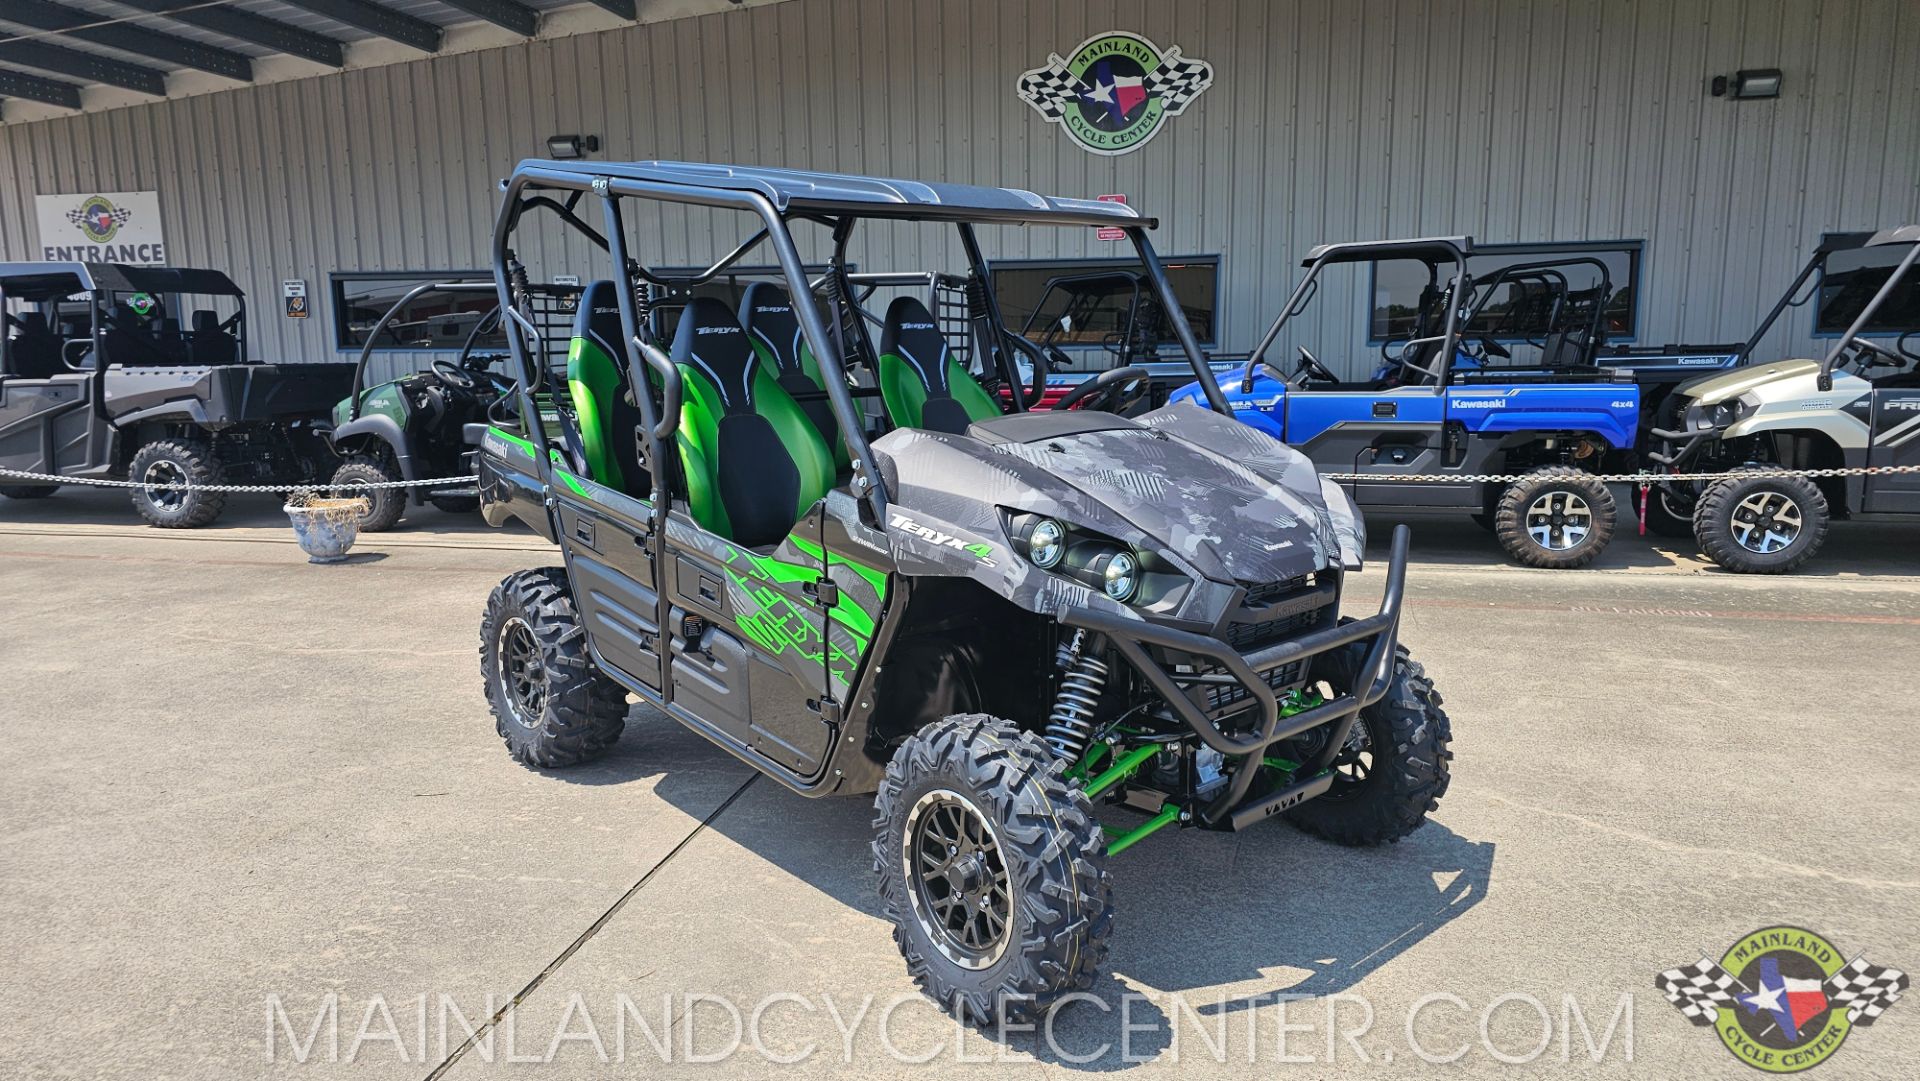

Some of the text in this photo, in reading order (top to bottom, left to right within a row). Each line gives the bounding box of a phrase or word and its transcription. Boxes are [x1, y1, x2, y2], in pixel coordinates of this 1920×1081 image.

[1078, 41, 1150, 67] MAINLAND
[1071, 110, 1157, 144] CYCLE CENTER
[44, 244, 164, 263] ENTRANCE
[1677, 357, 1718, 365] Kawasaki
[1451, 399, 1506, 409] Kawasaki
[484, 432, 509, 459] Kawasaki
[1263, 540, 1294, 552] Kawasaki
